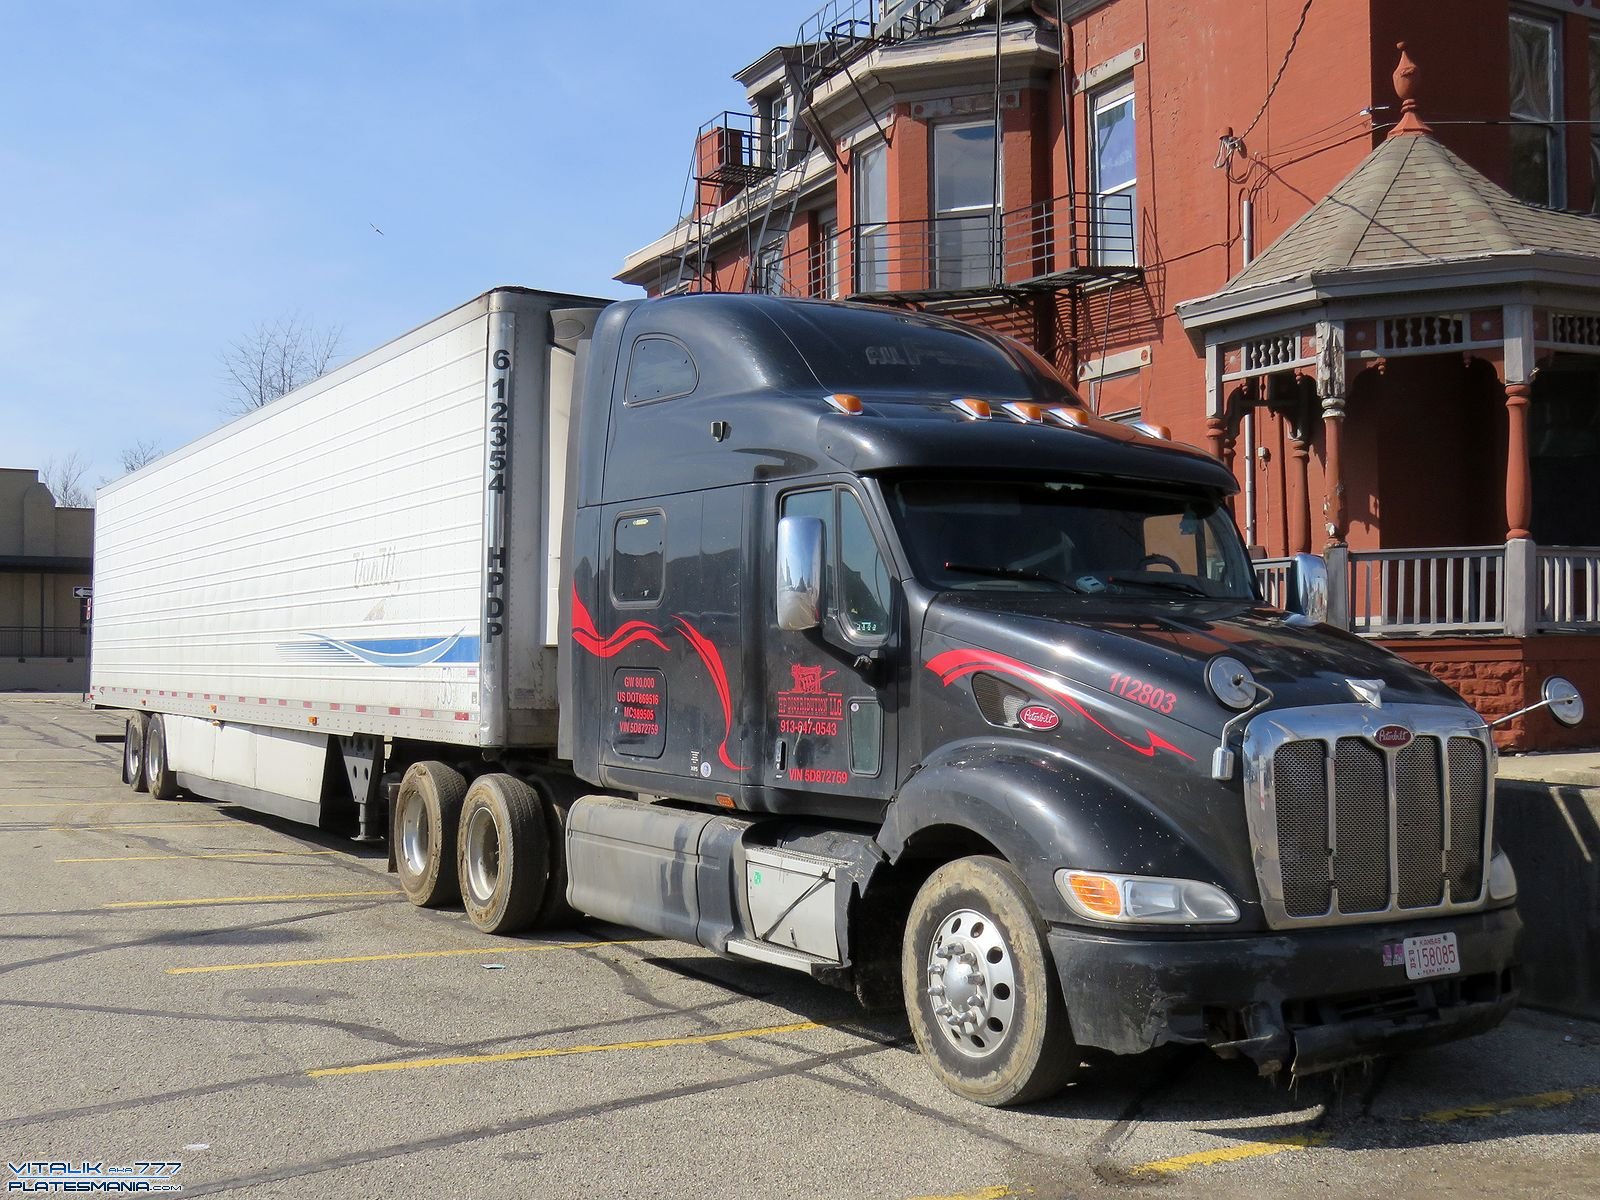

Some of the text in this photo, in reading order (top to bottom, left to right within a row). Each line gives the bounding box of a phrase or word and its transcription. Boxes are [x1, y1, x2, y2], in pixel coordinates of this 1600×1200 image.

[488, 349, 511, 495] 612354
[487, 547, 506, 643] HPDP
[617, 691, 626, 703] US
[1109, 672, 1178, 714] 112803
[619, 721, 630, 733] VIN
[780, 719, 838, 736] 913-647-0543
[788, 767, 803, 781] VIN
[1416, 944, 1456, 969] 158085
